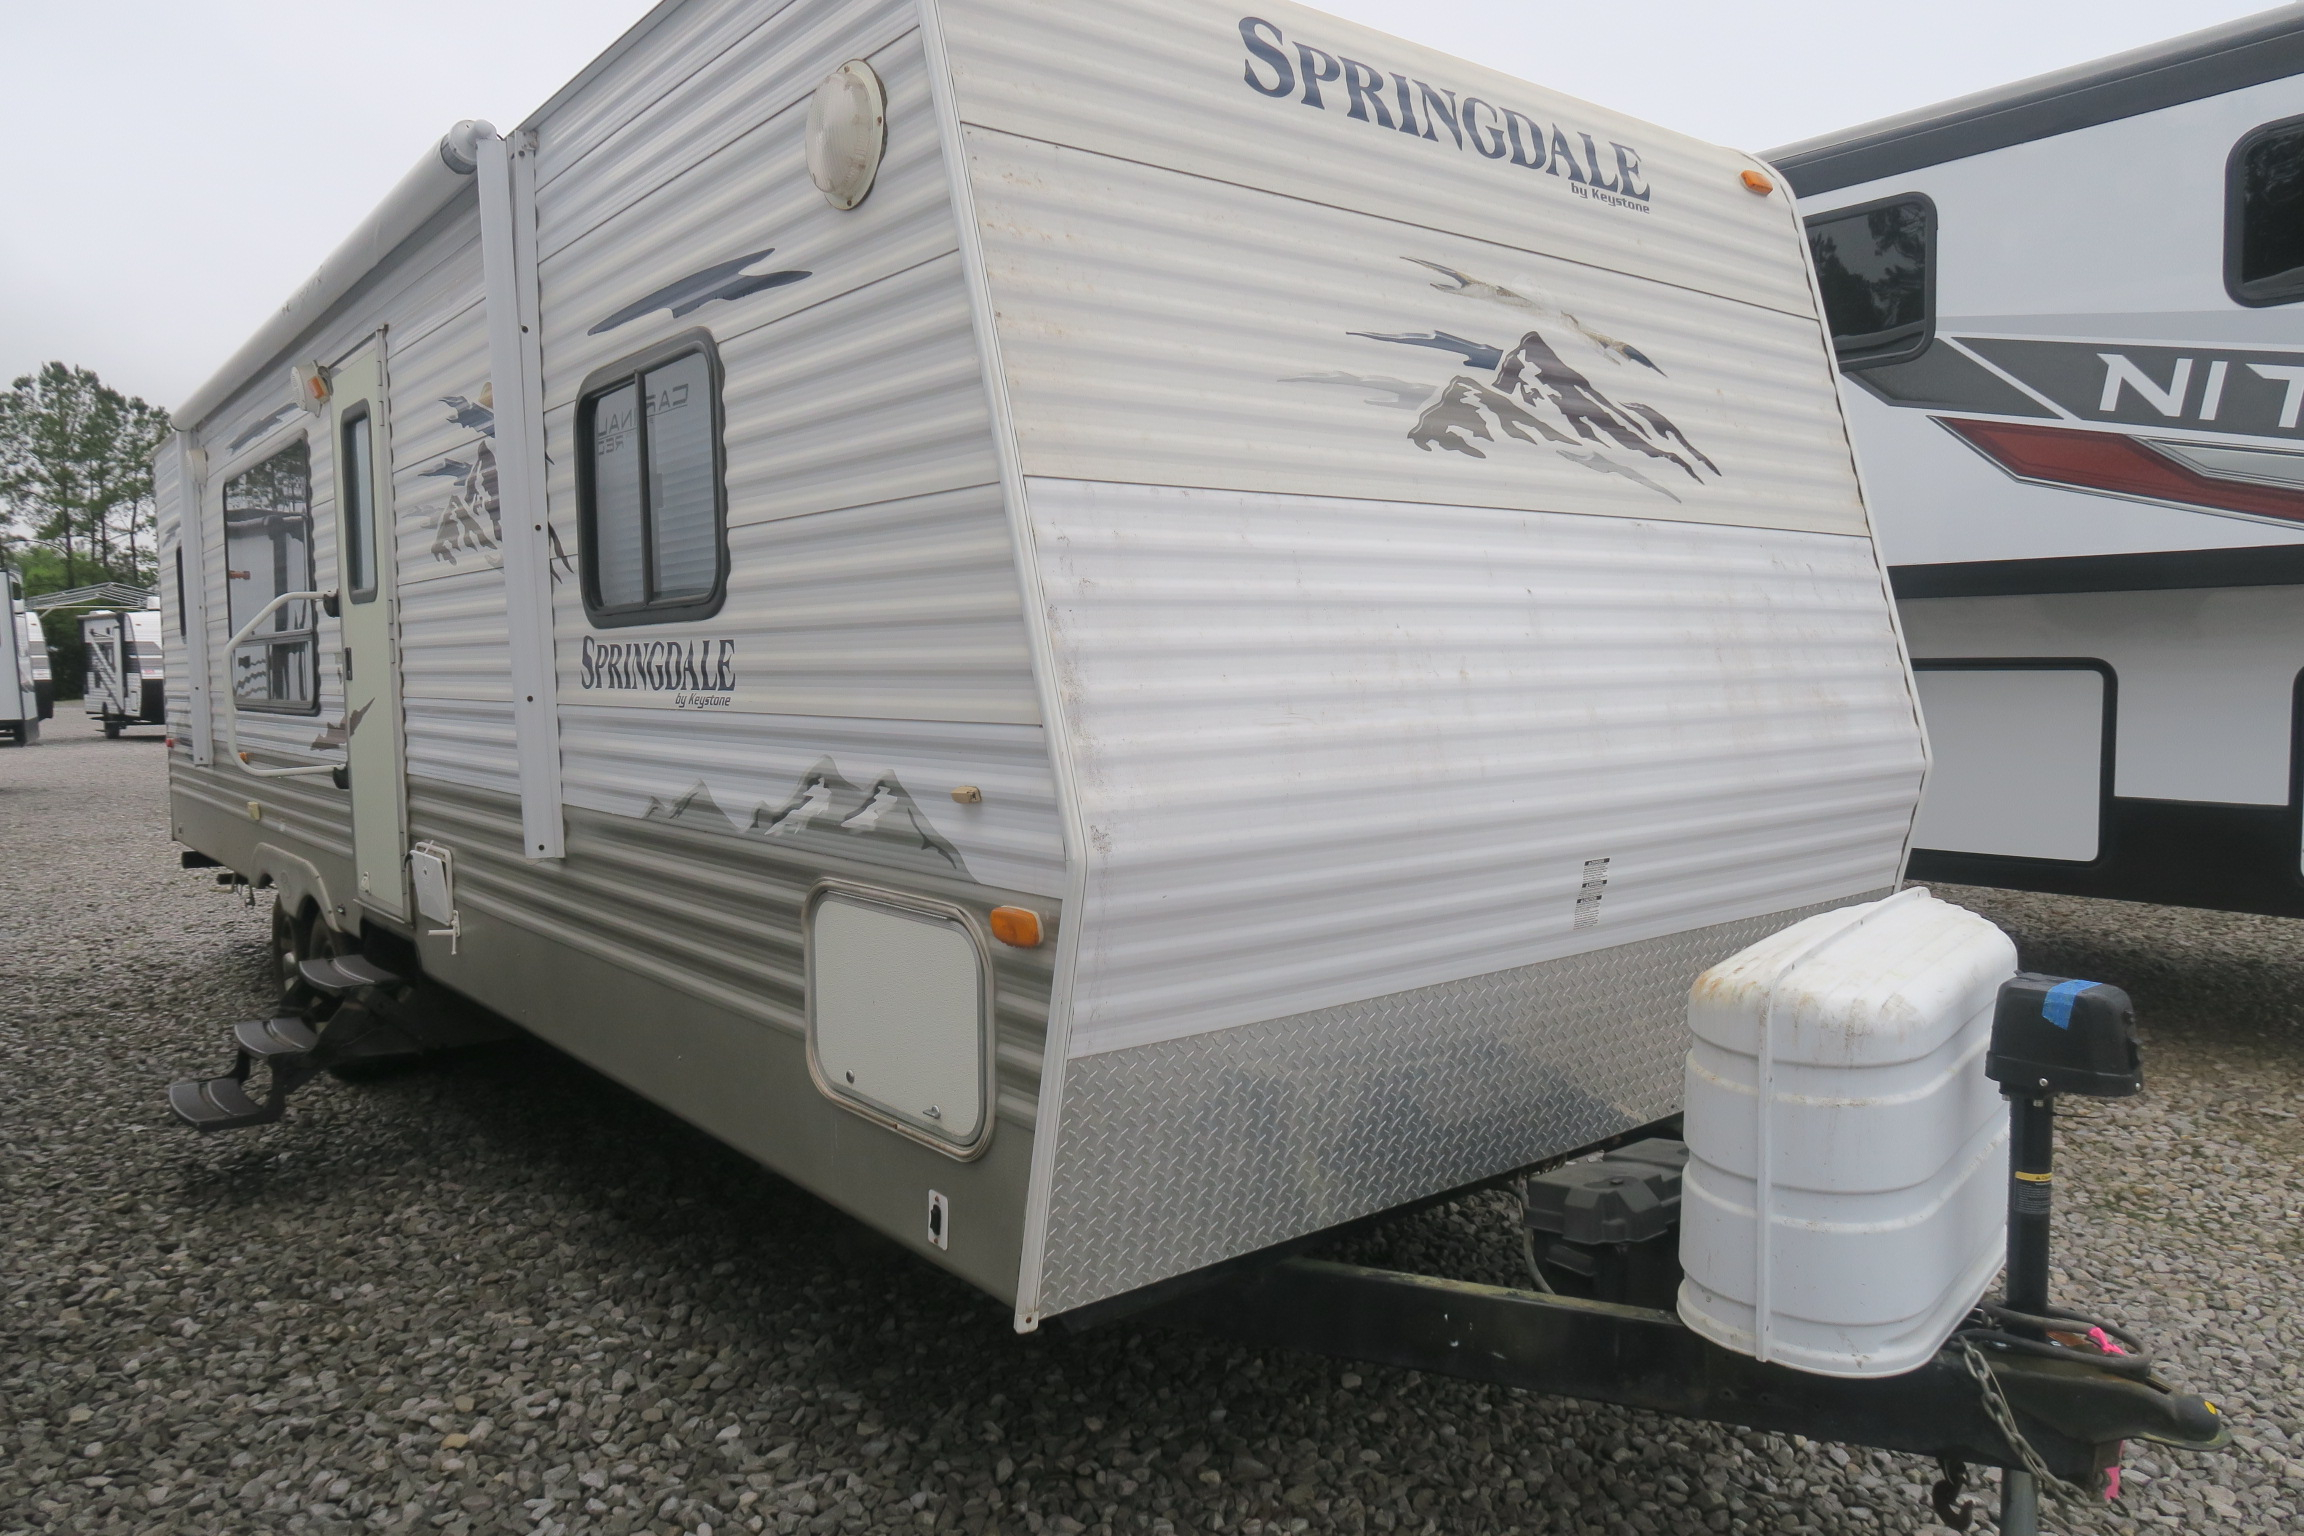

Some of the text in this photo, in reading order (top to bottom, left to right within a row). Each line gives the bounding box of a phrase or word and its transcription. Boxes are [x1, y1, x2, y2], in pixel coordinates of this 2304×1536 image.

[1238, 16, 1651, 202] SPRINGDALE
[1571, 182, 1650, 214] by Keystone
[580, 635, 736, 692] SPRINGDALE
[675, 693, 731, 708] by Keystone
